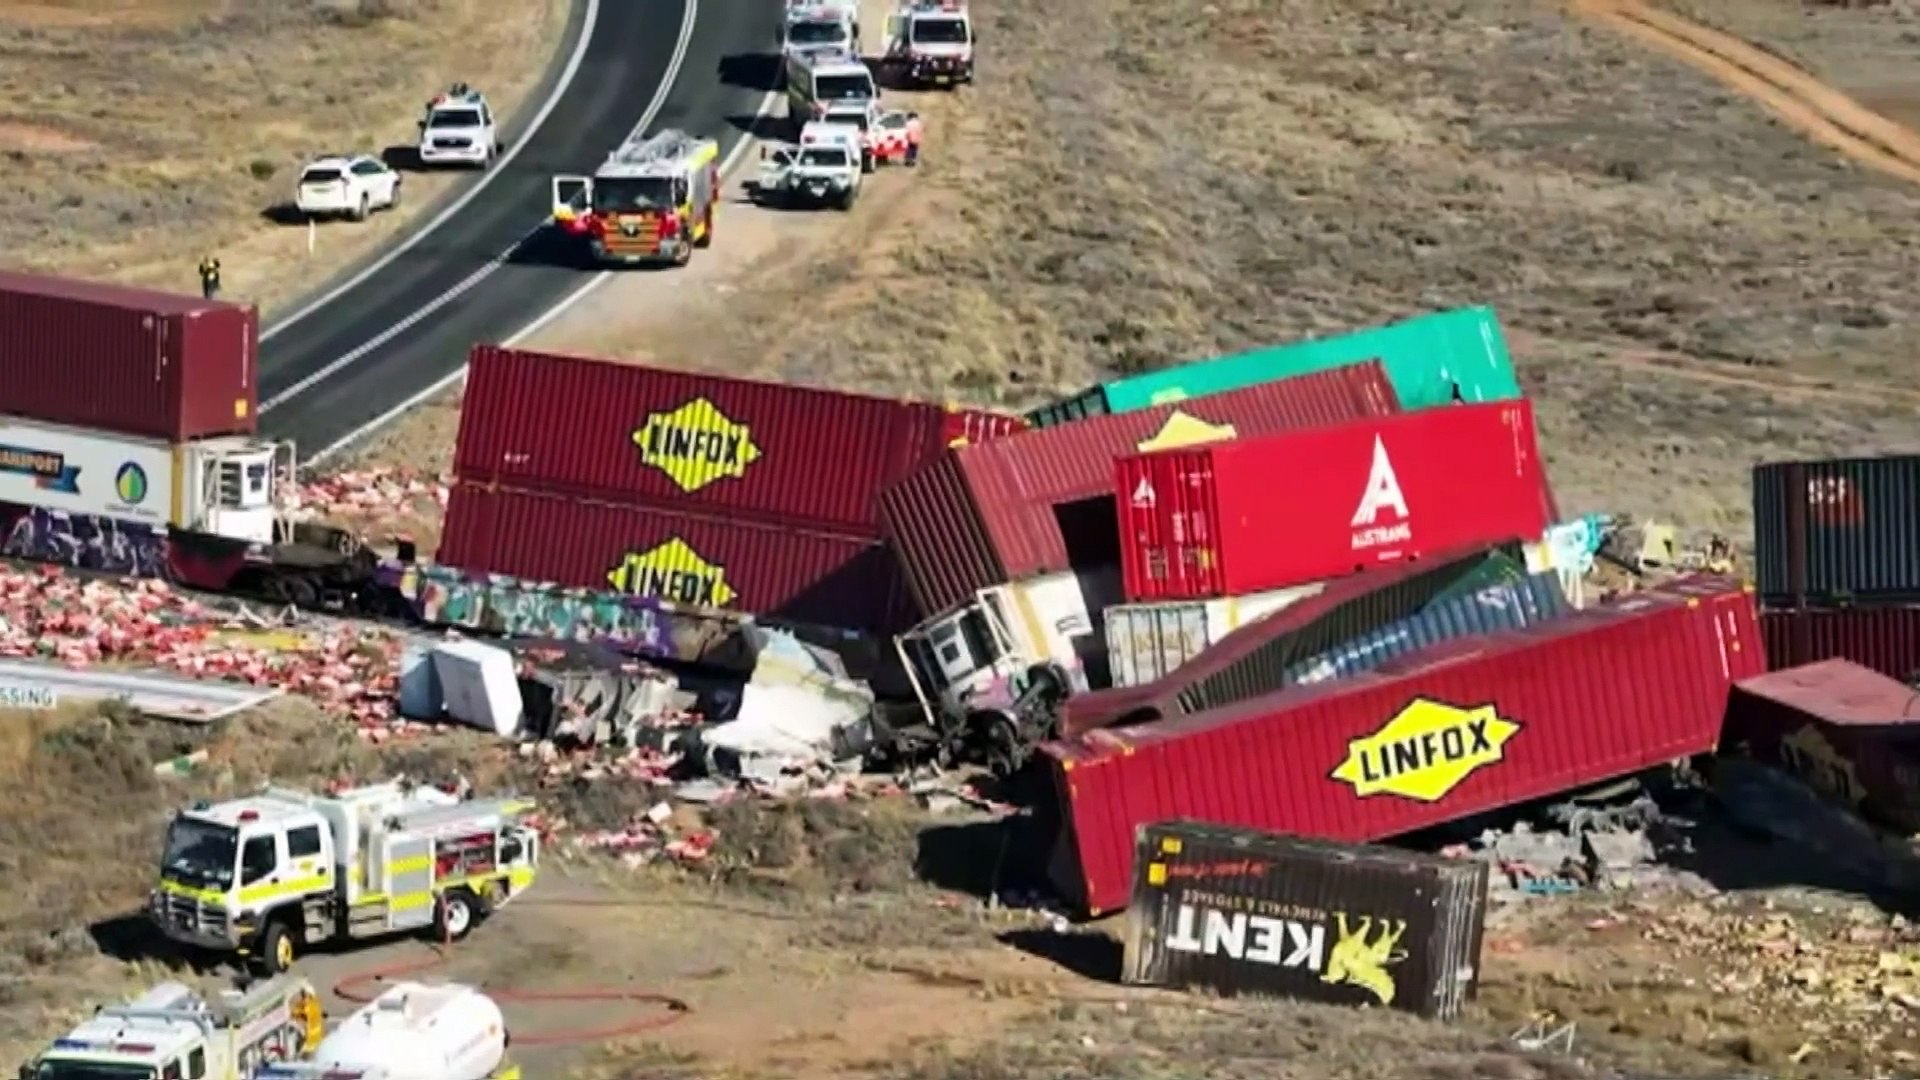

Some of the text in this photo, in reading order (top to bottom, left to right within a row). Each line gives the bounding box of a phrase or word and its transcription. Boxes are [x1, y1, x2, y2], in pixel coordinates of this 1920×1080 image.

[650, 425, 742, 465] LINFOX
[624, 562, 714, 604] LINFOX
[1360, 717, 1492, 783] LINFOX
[1165, 904, 1325, 971] KENT
